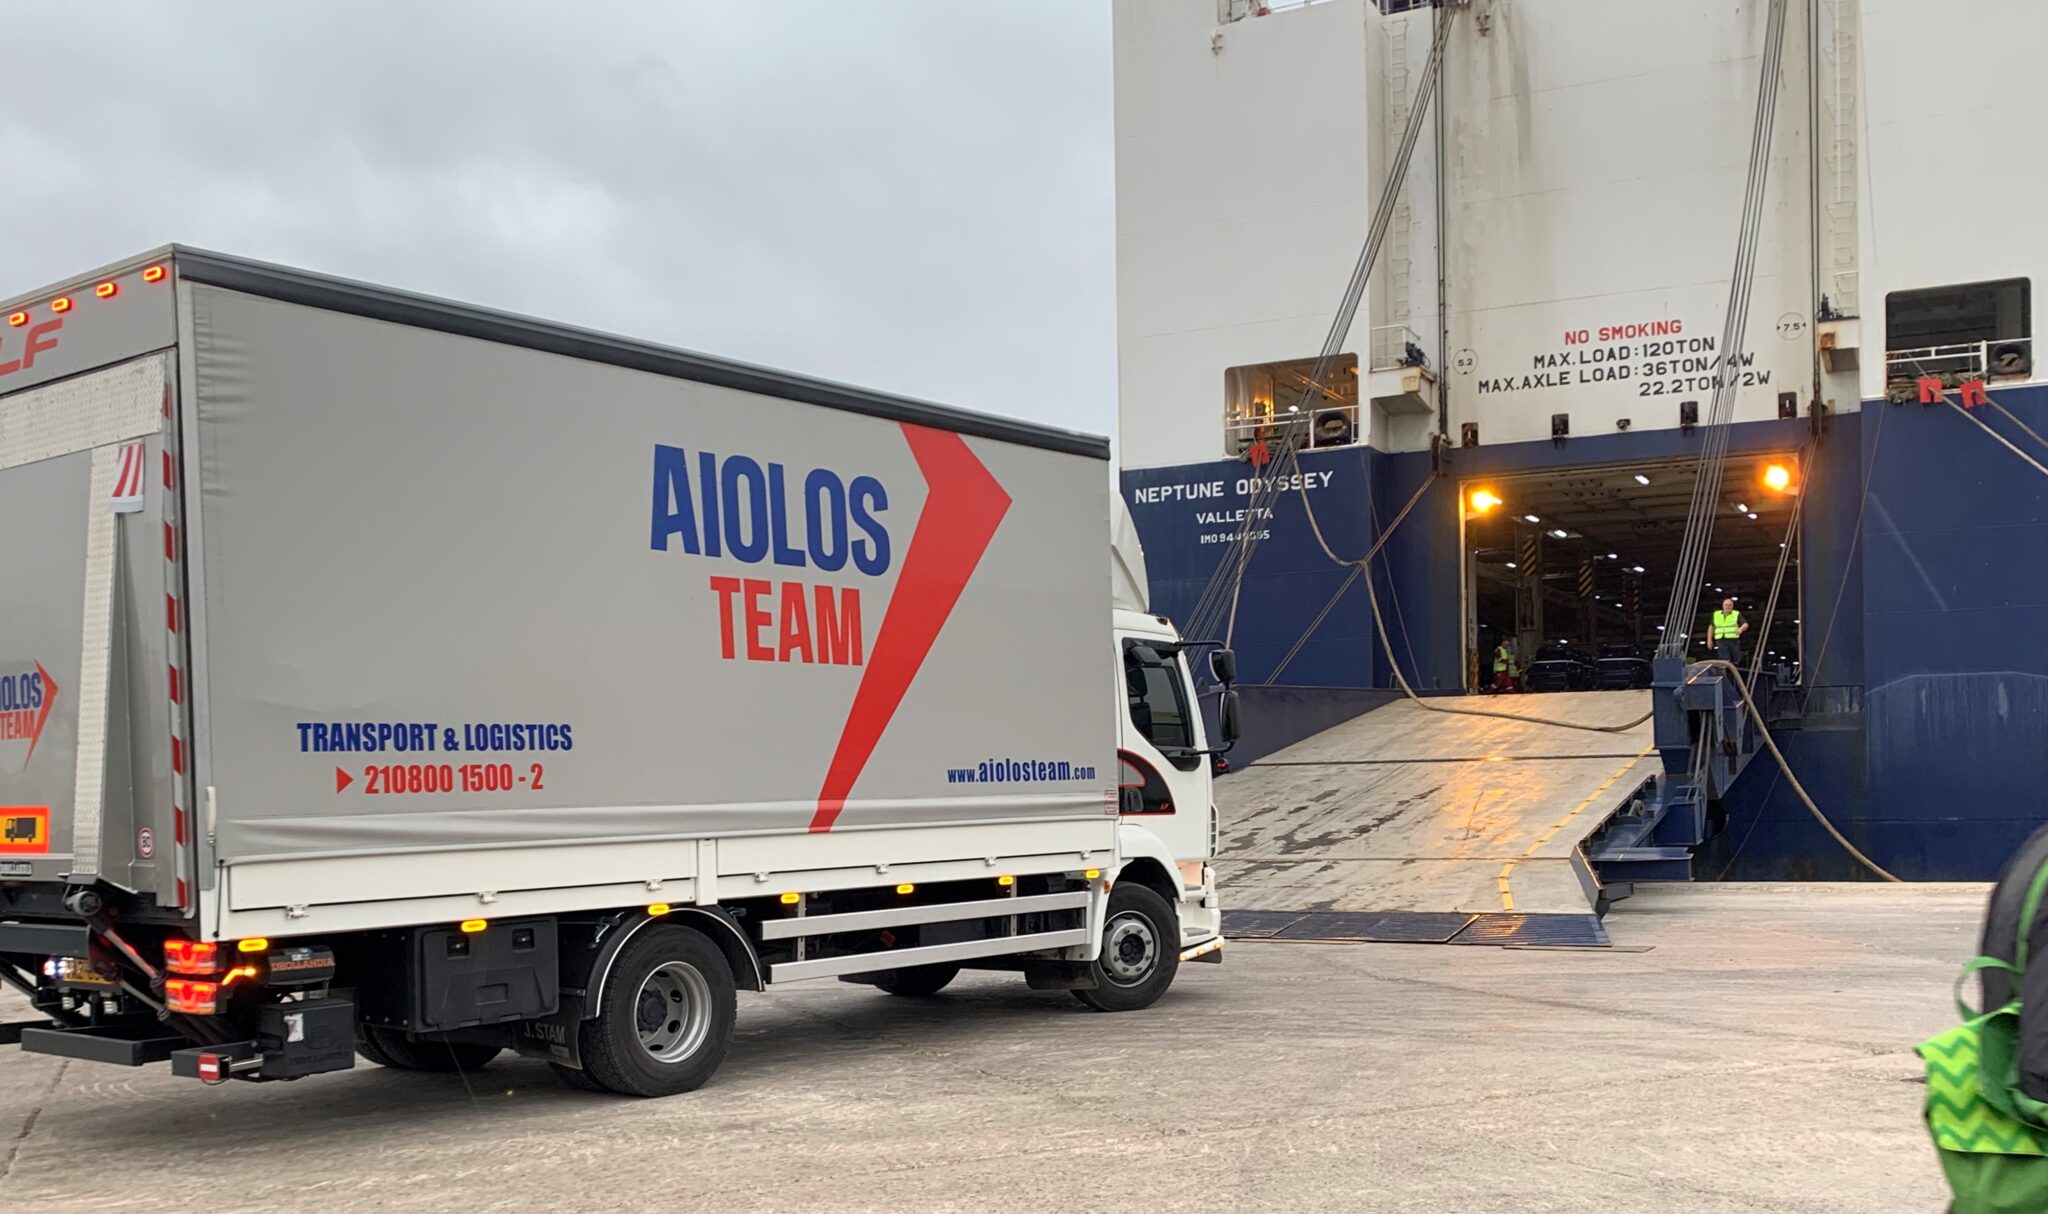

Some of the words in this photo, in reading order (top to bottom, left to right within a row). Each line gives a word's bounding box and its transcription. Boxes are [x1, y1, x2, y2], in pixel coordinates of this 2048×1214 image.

[1564, 329, 1589, 345] NO
[1598, 319, 1682, 341] SMOKING
[1458, 358, 1473, 366] 5.2
[1135, 481, 1225, 504] NEPTUNE
[650, 443, 891, 576] AIOLOS
[1196, 507, 1274, 524] VALLETA
[709, 575, 864, 666] TEAM
[0, 710, 35, 740] TEAM
[296, 723, 437, 752] TRANSPORT
[443, 728, 460, 751] &
[464, 723, 573, 751] LOGISTICS
[364, 764, 453, 794] 210800
[947, 758, 1096, 783] www.aiolosteam.com
